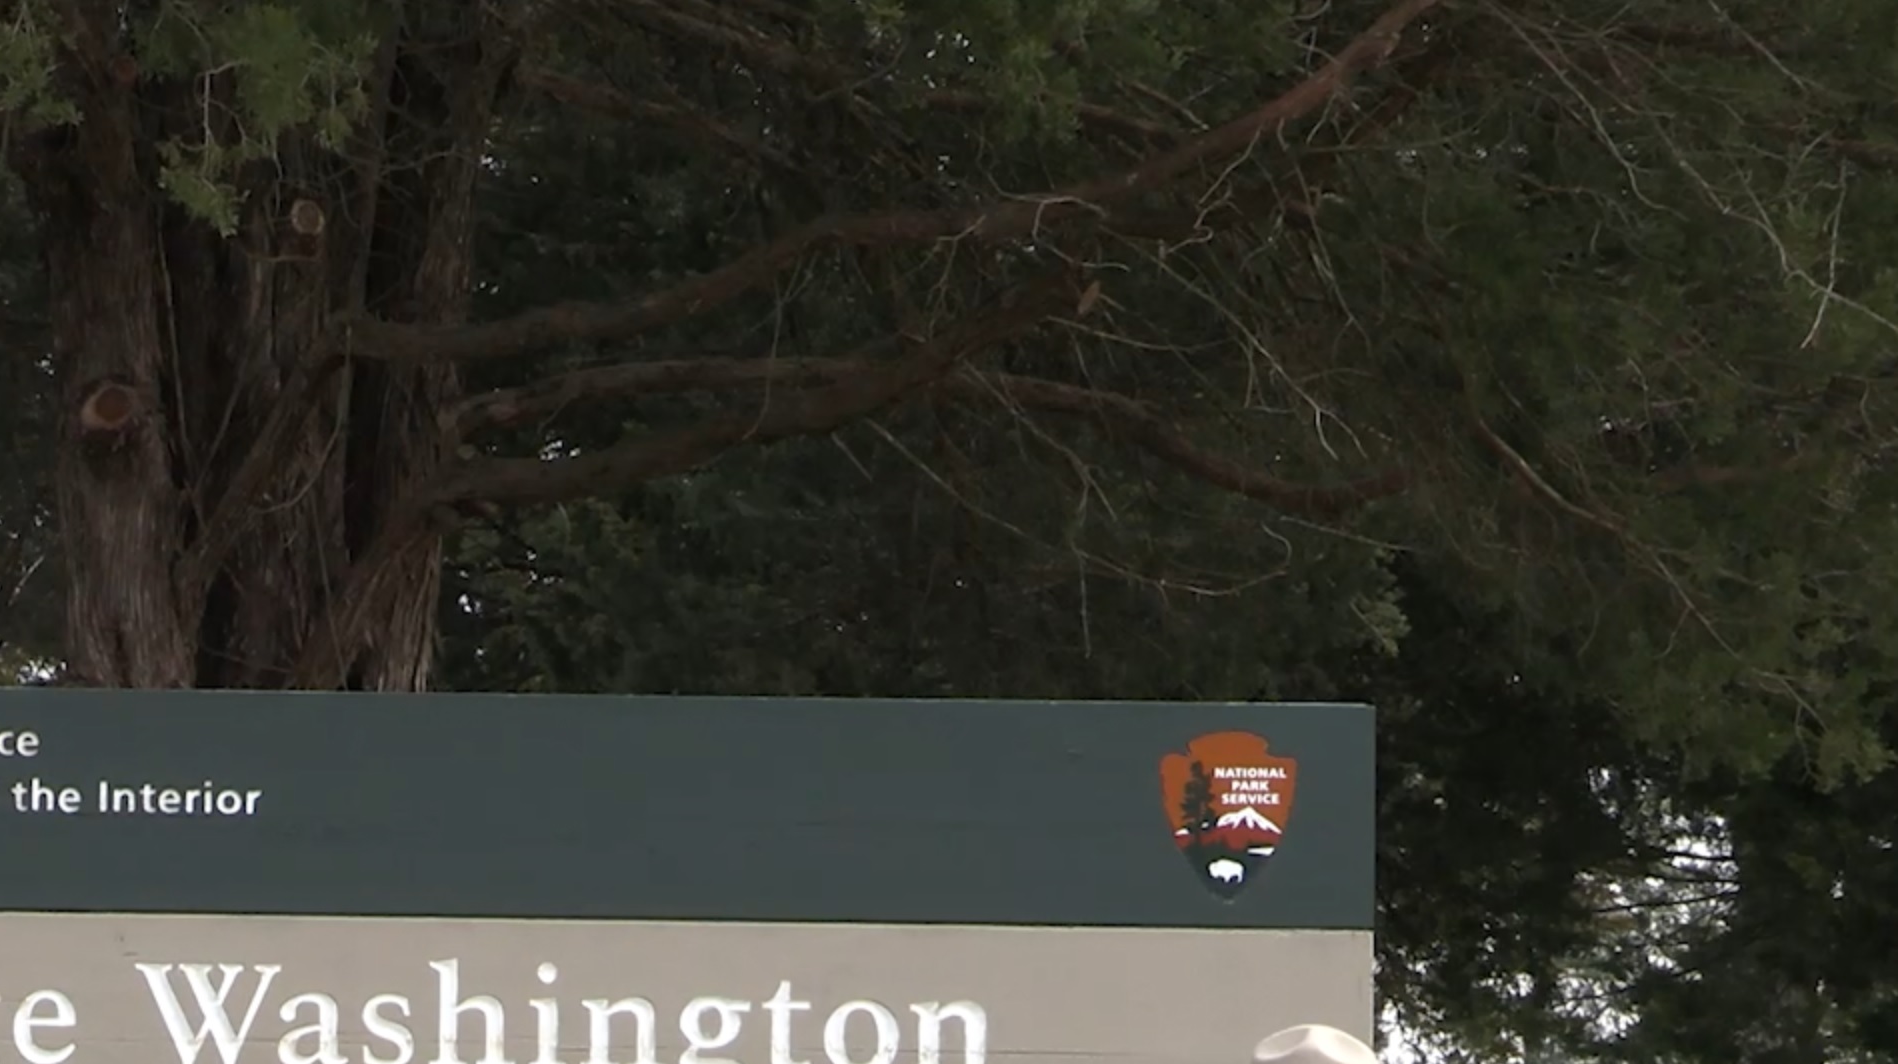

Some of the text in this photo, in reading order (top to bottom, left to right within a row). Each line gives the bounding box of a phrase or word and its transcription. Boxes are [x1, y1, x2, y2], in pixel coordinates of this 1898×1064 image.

[1214, 767, 1287, 779] NATIONAL
[1231, 780, 1270, 791] PARK
[11, 777, 81, 813] the
[99, 780, 262, 815] Interior
[1221, 793, 1281, 805] SERVICE
